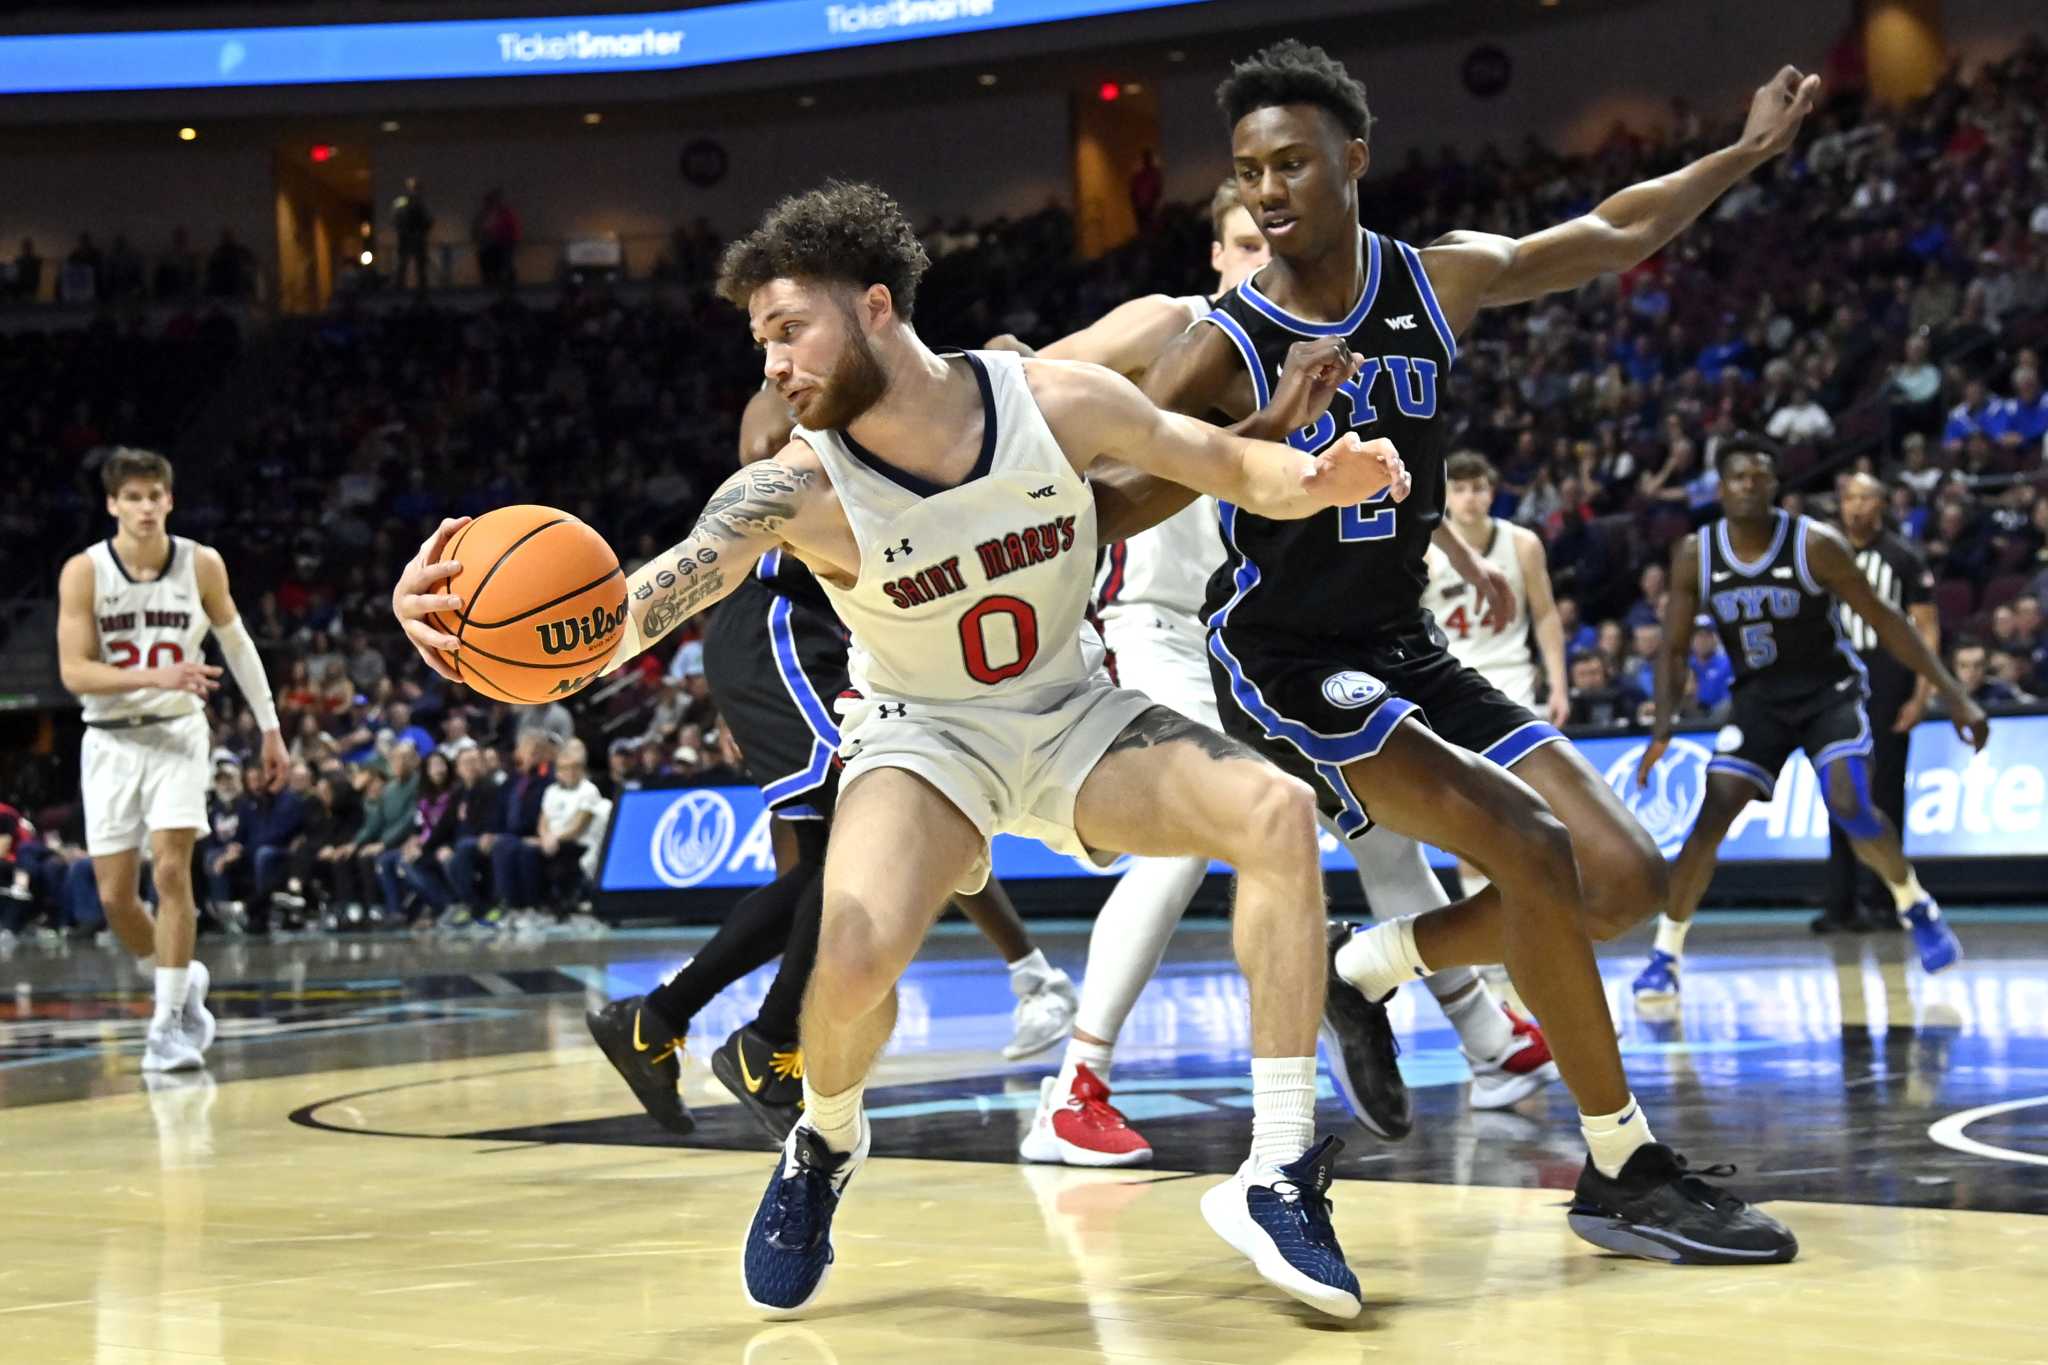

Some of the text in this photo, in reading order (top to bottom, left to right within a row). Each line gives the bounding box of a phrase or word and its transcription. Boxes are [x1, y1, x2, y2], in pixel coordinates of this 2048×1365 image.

[498, 28, 686, 62] TicketSmarter
[1384, 314, 1418, 330] WCC
[1027, 485, 1057, 499] WCC
[883, 515, 1075, 609] SAINT MARY'S
[958, 595, 1038, 685] 0
[1740, 622, 1777, 669] 5
